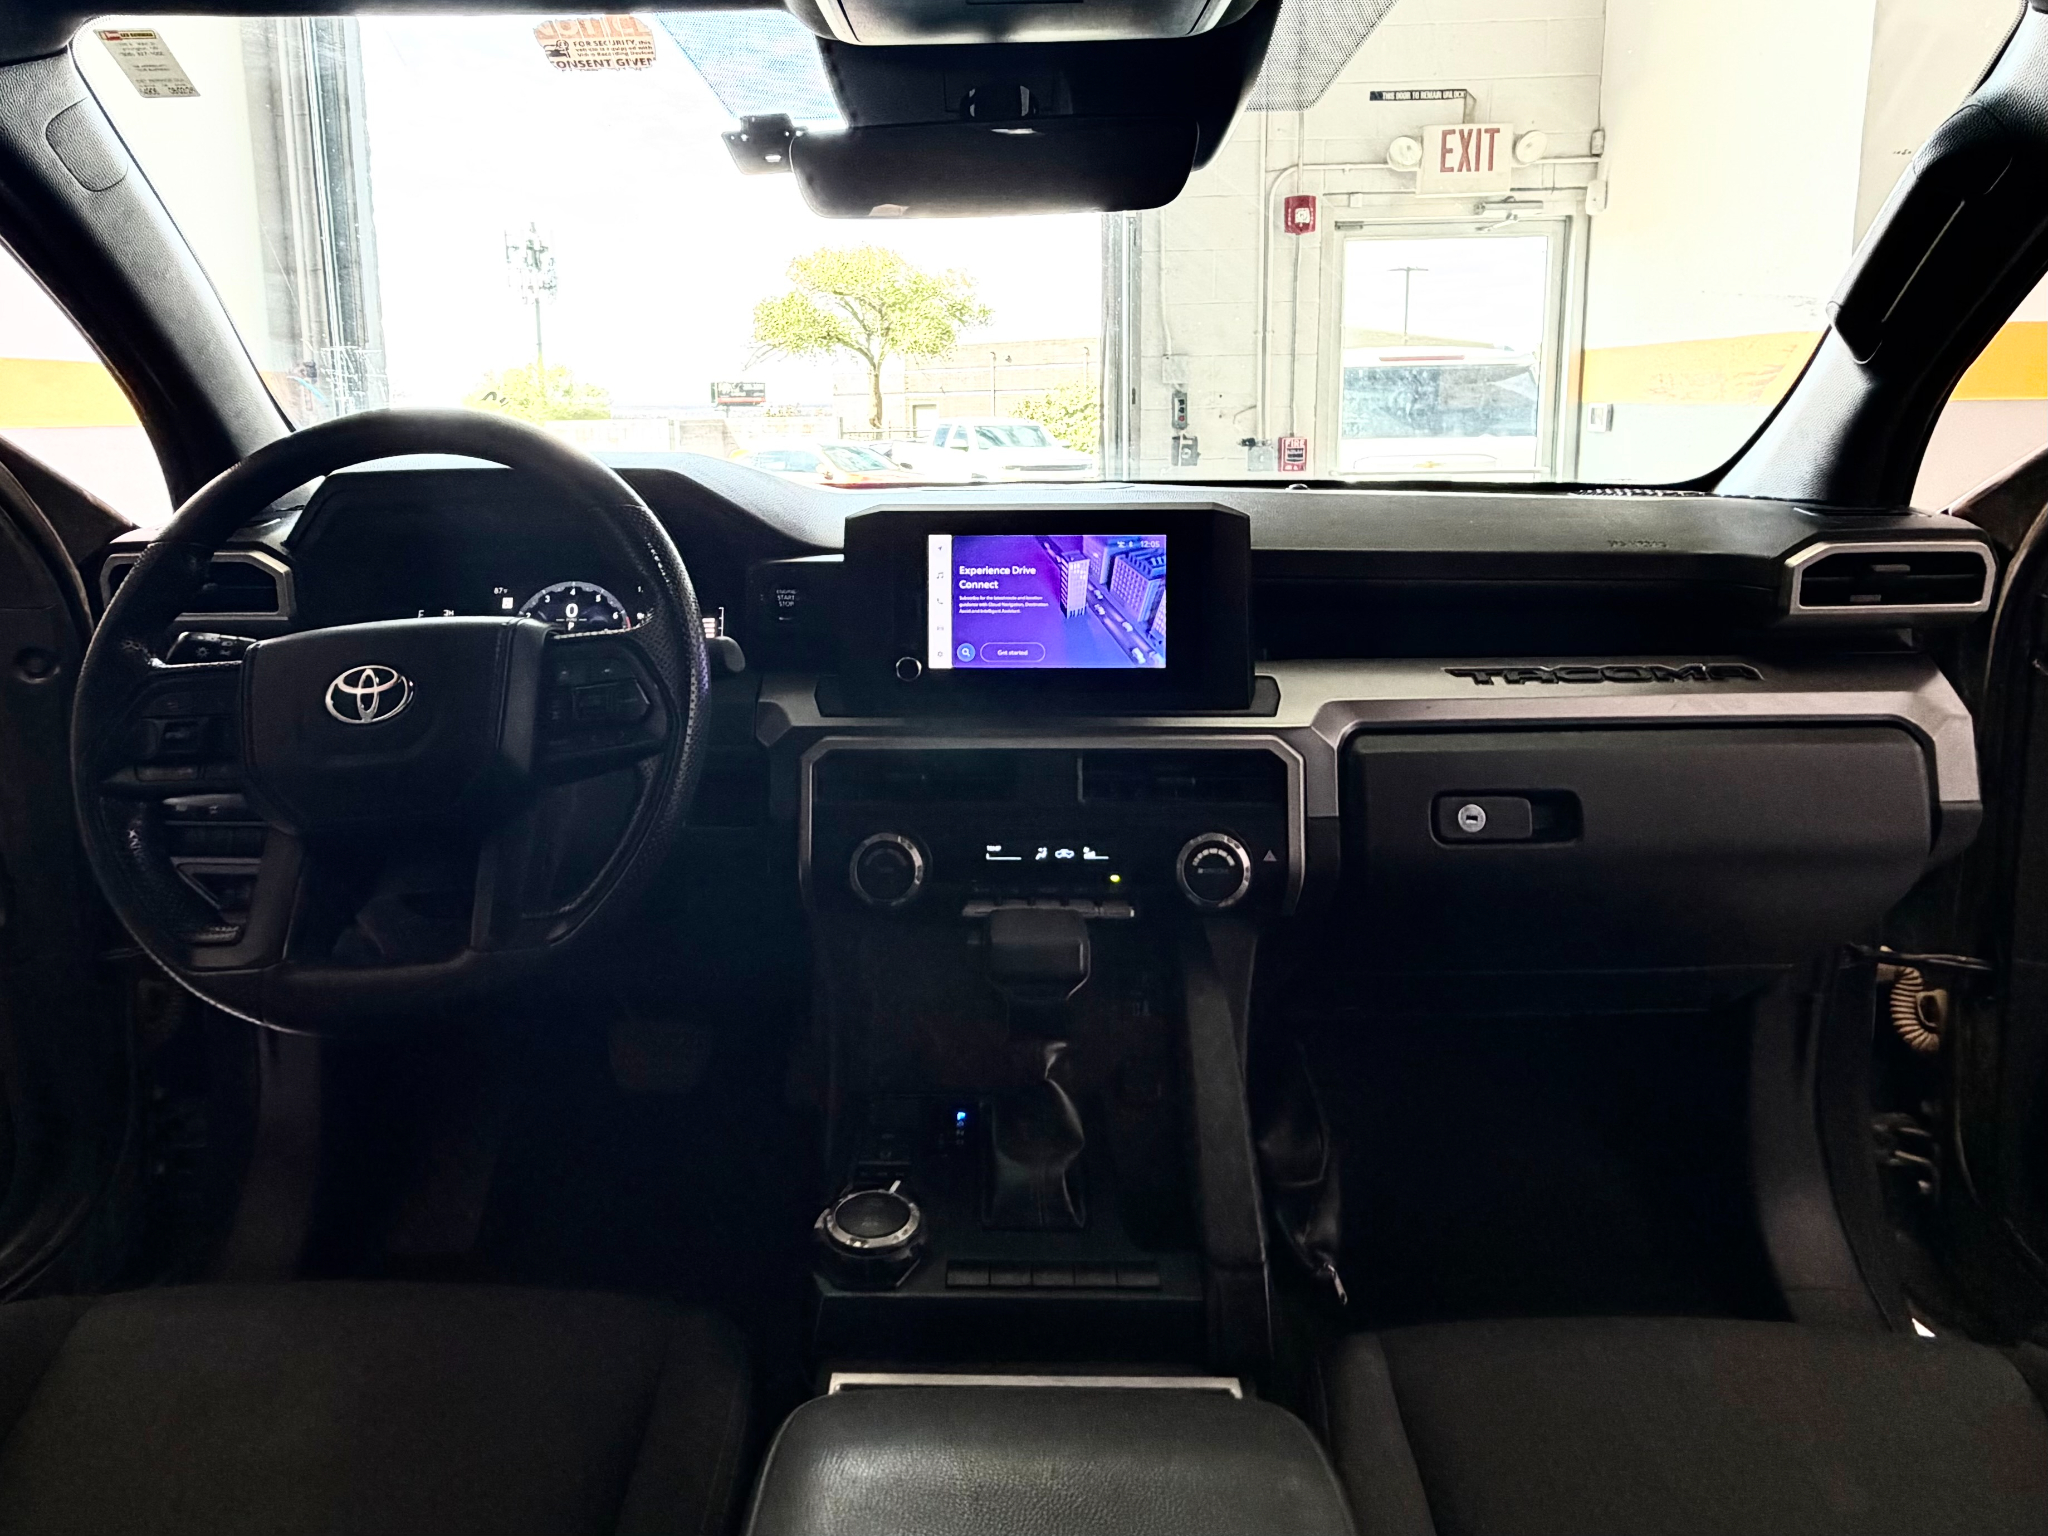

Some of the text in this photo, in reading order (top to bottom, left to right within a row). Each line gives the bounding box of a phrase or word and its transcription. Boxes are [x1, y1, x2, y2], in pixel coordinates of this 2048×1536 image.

[550, 59, 612, 69] ONSENT
[1439, 127, 1501, 173] EXIT
[1140, 540, 1160, 548] 12:05
[959, 566, 1037, 576] Experience Drive
[959, 580, 999, 589] Connect
[1441, 662, 1765, 686] TACOMA
